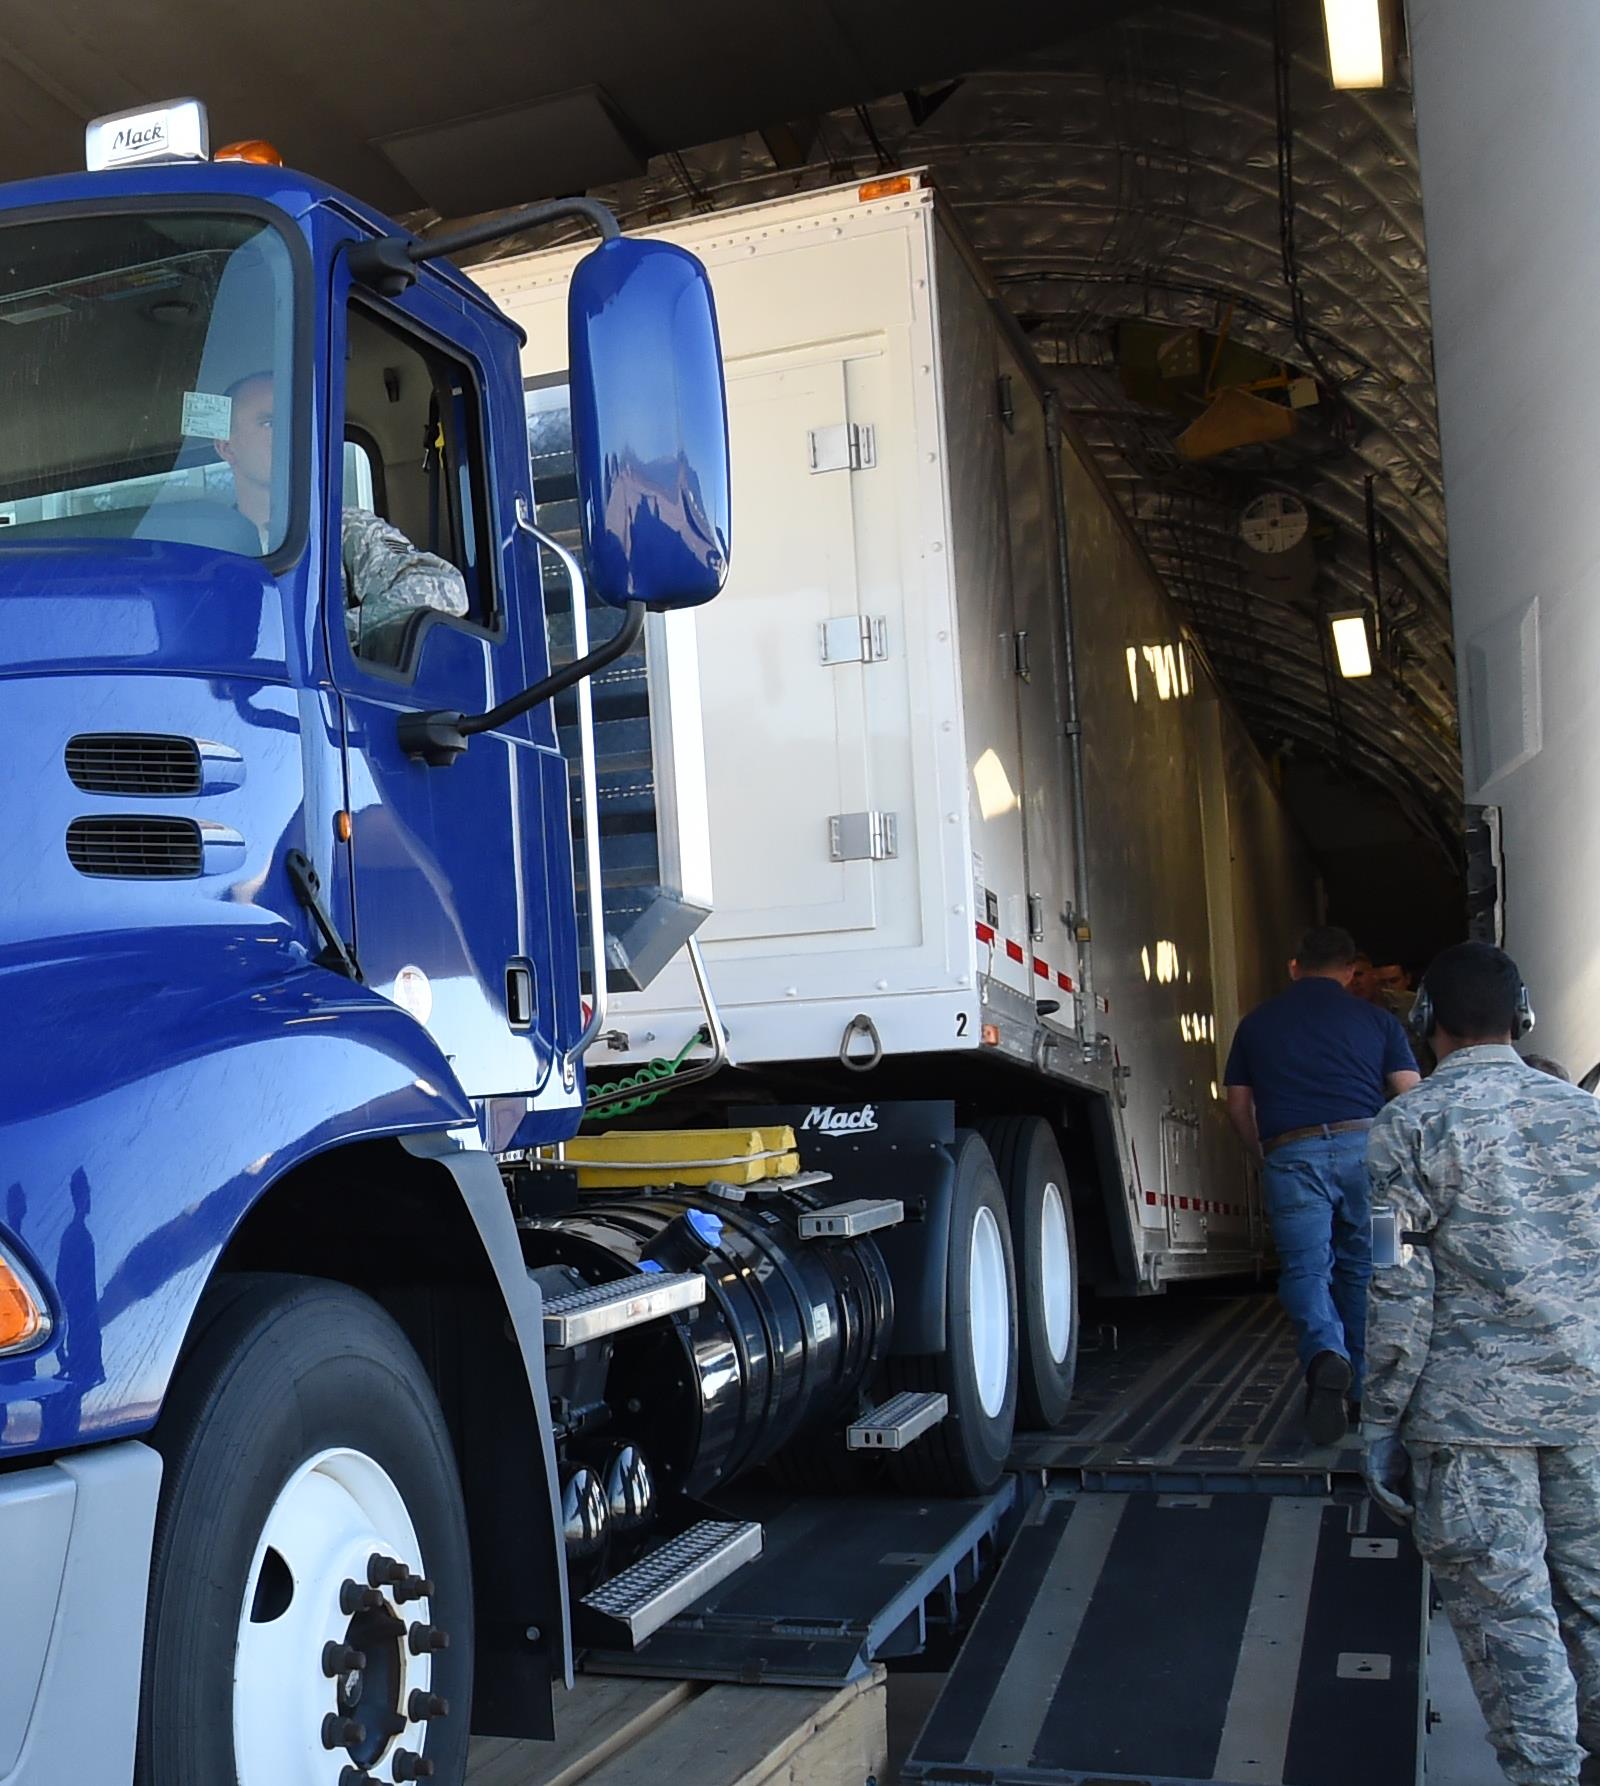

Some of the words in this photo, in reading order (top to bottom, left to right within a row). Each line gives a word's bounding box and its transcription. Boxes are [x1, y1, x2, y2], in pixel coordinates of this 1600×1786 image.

[112, 123, 164, 150] Mack
[956, 1012, 968, 1037] 2
[800, 1104, 878, 1137] Mack
